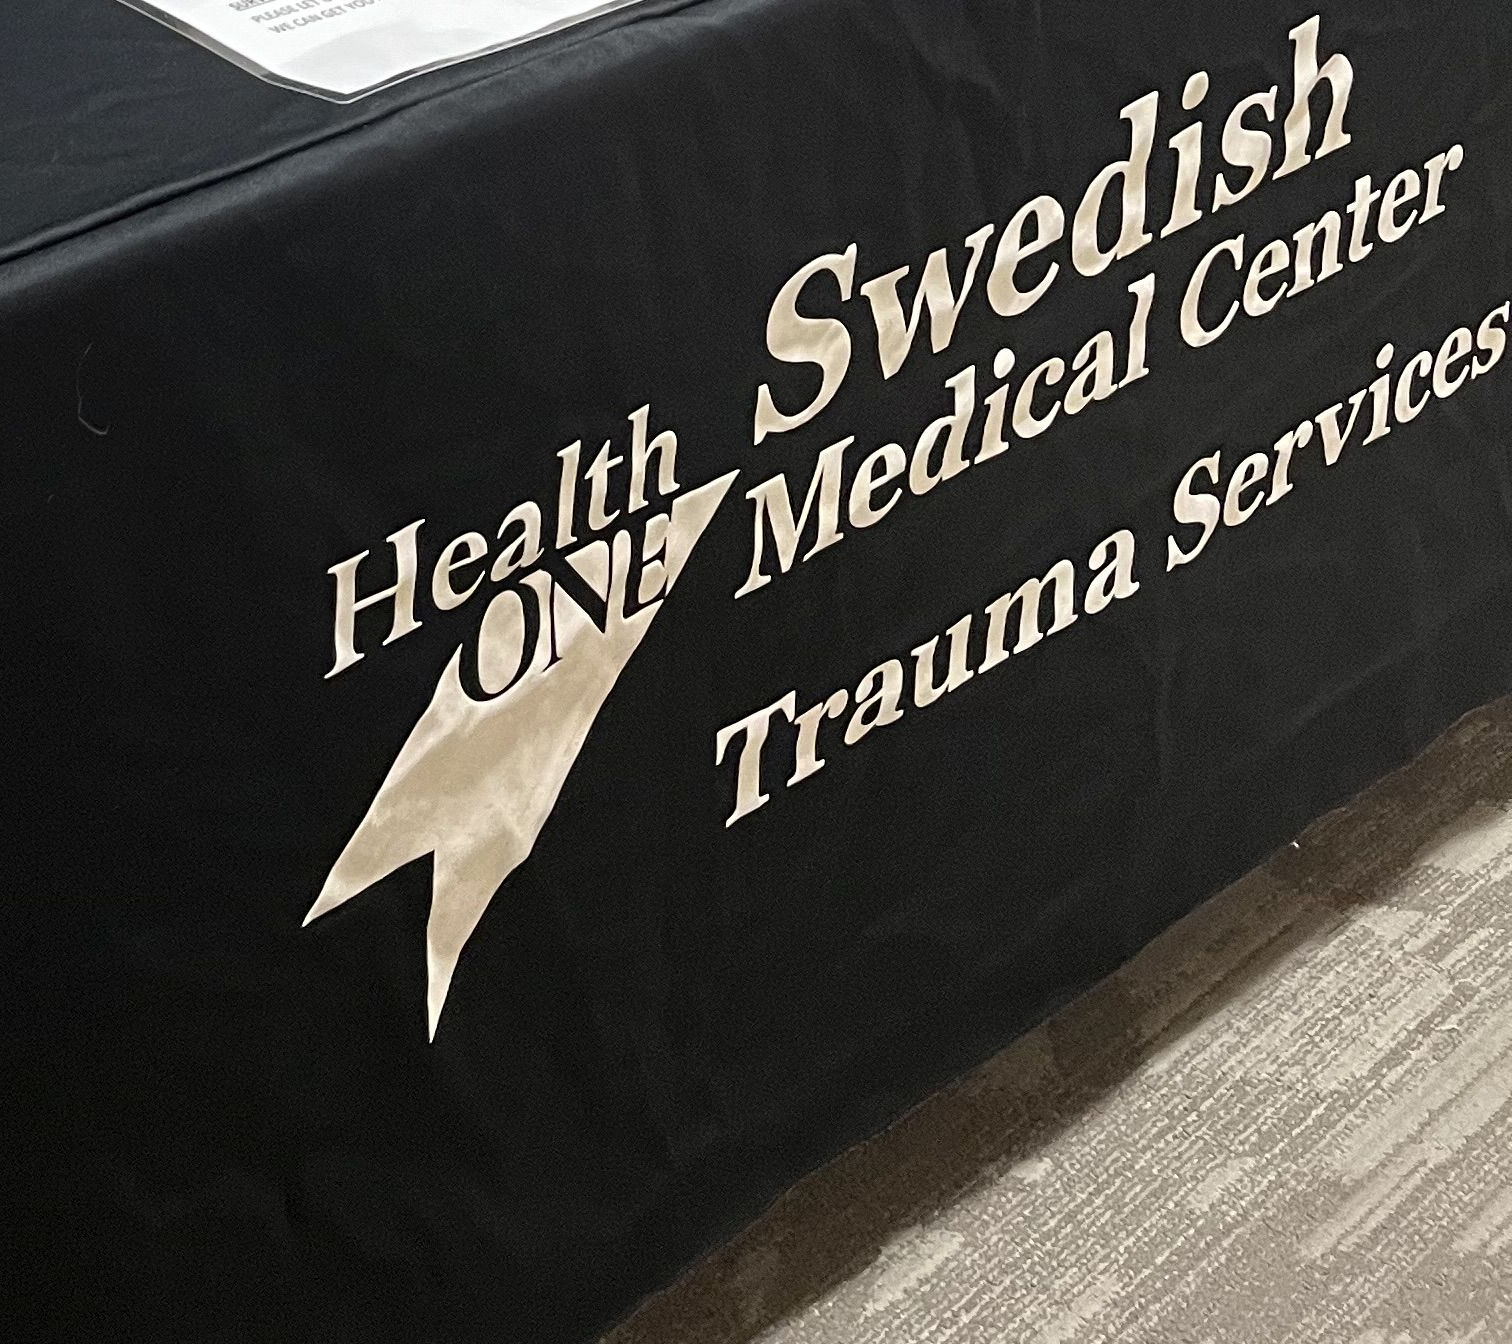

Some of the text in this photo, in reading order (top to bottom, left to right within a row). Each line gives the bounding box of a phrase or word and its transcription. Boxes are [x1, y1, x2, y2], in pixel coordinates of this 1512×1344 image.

[250, 4, 299, 23] PLEASE
[268, 22, 295, 34] WE
[292, 14, 323, 27] CAN
[320, 6, 347, 18] GET
[752, 14, 1355, 447] Swedish
[734, 144, 1464, 599] Medical Center
[323, 404, 681, 679] Health
[453, 514, 678, 706] ONE
[714, 299, 1511, 829] Trauma Services
